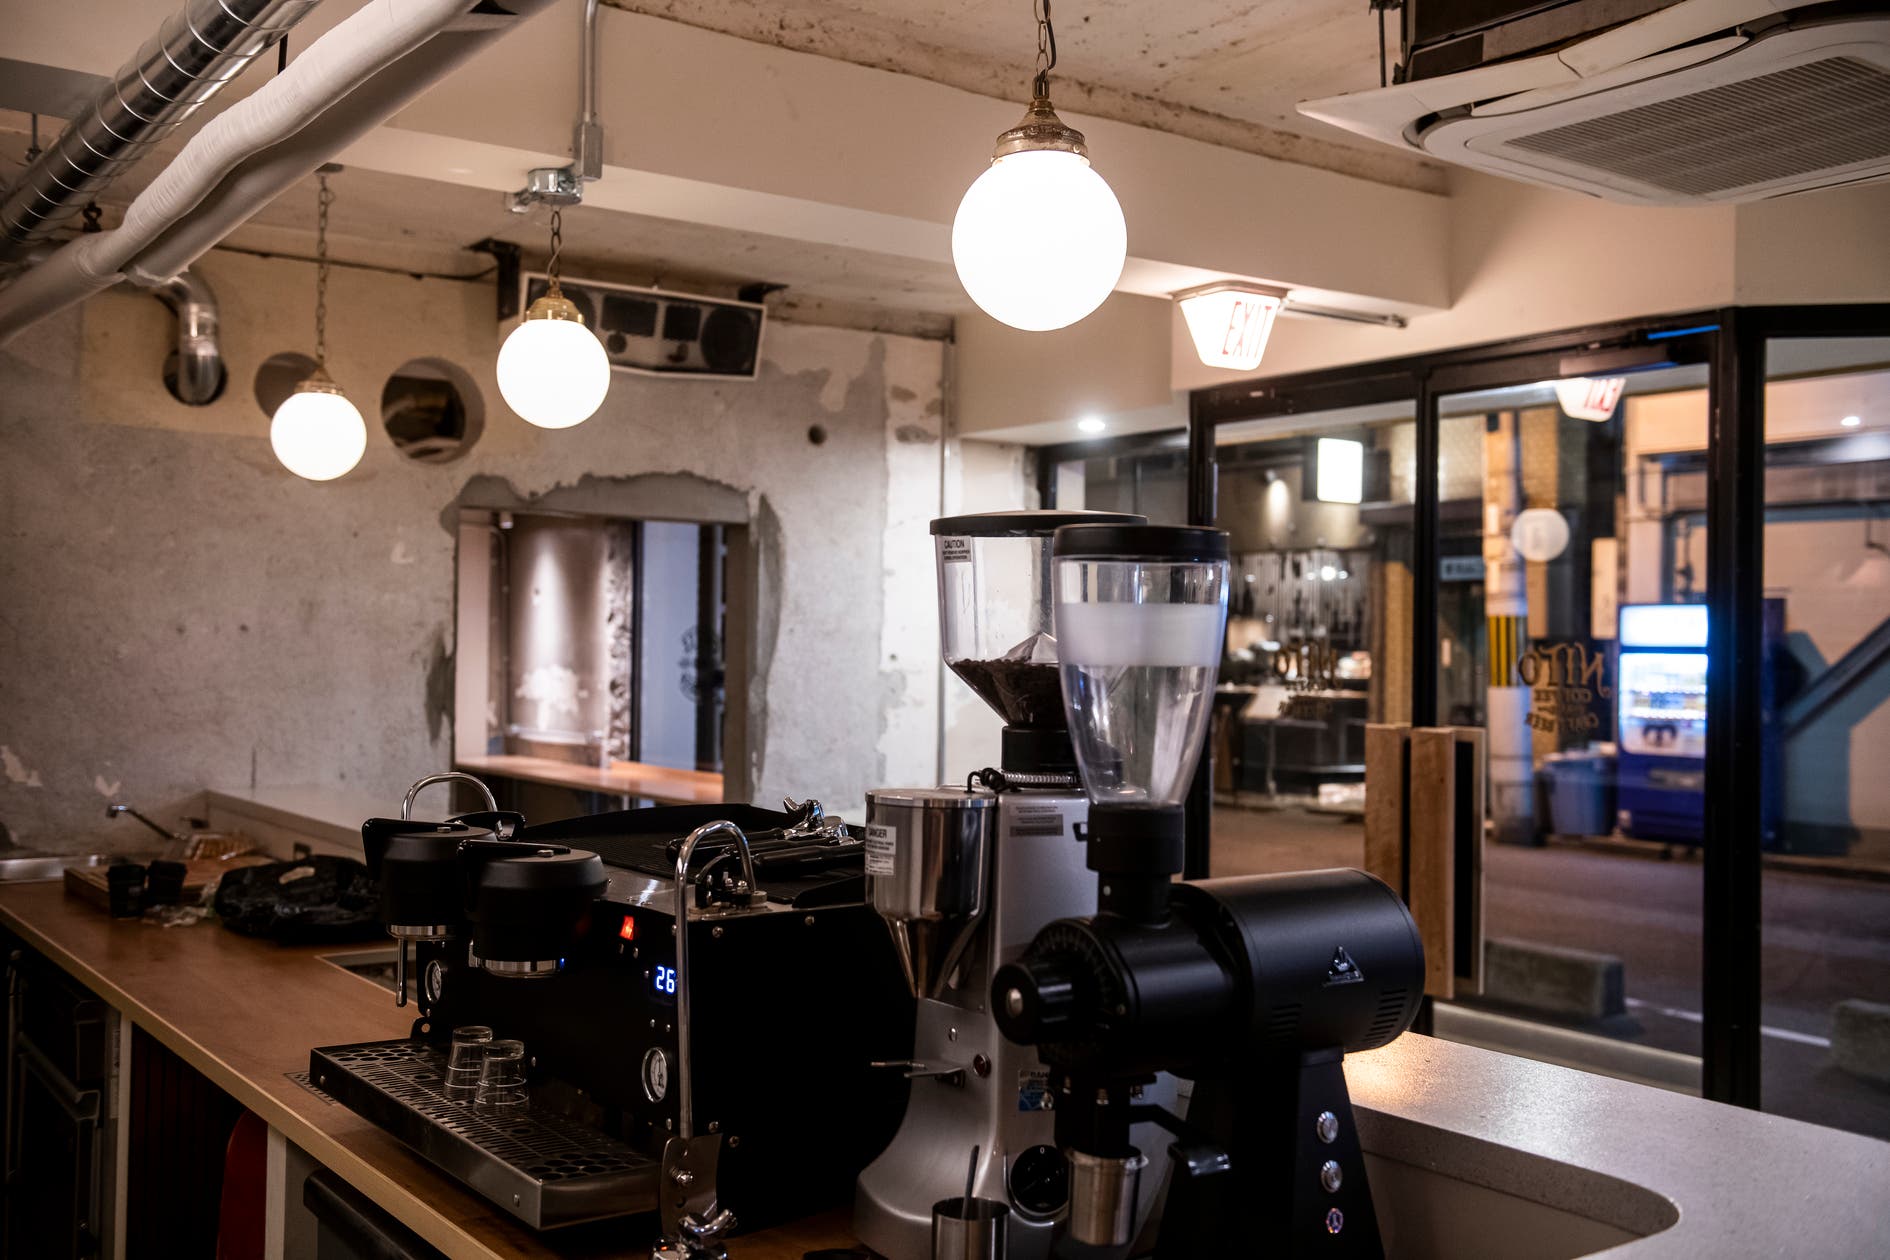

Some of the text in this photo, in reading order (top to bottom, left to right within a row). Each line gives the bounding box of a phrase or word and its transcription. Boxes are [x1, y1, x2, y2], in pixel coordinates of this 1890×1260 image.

[1222, 301, 1273, 359] EXIT
[944, 539, 965, 549] CAUTION
[656, 965, 676, 994] 26
